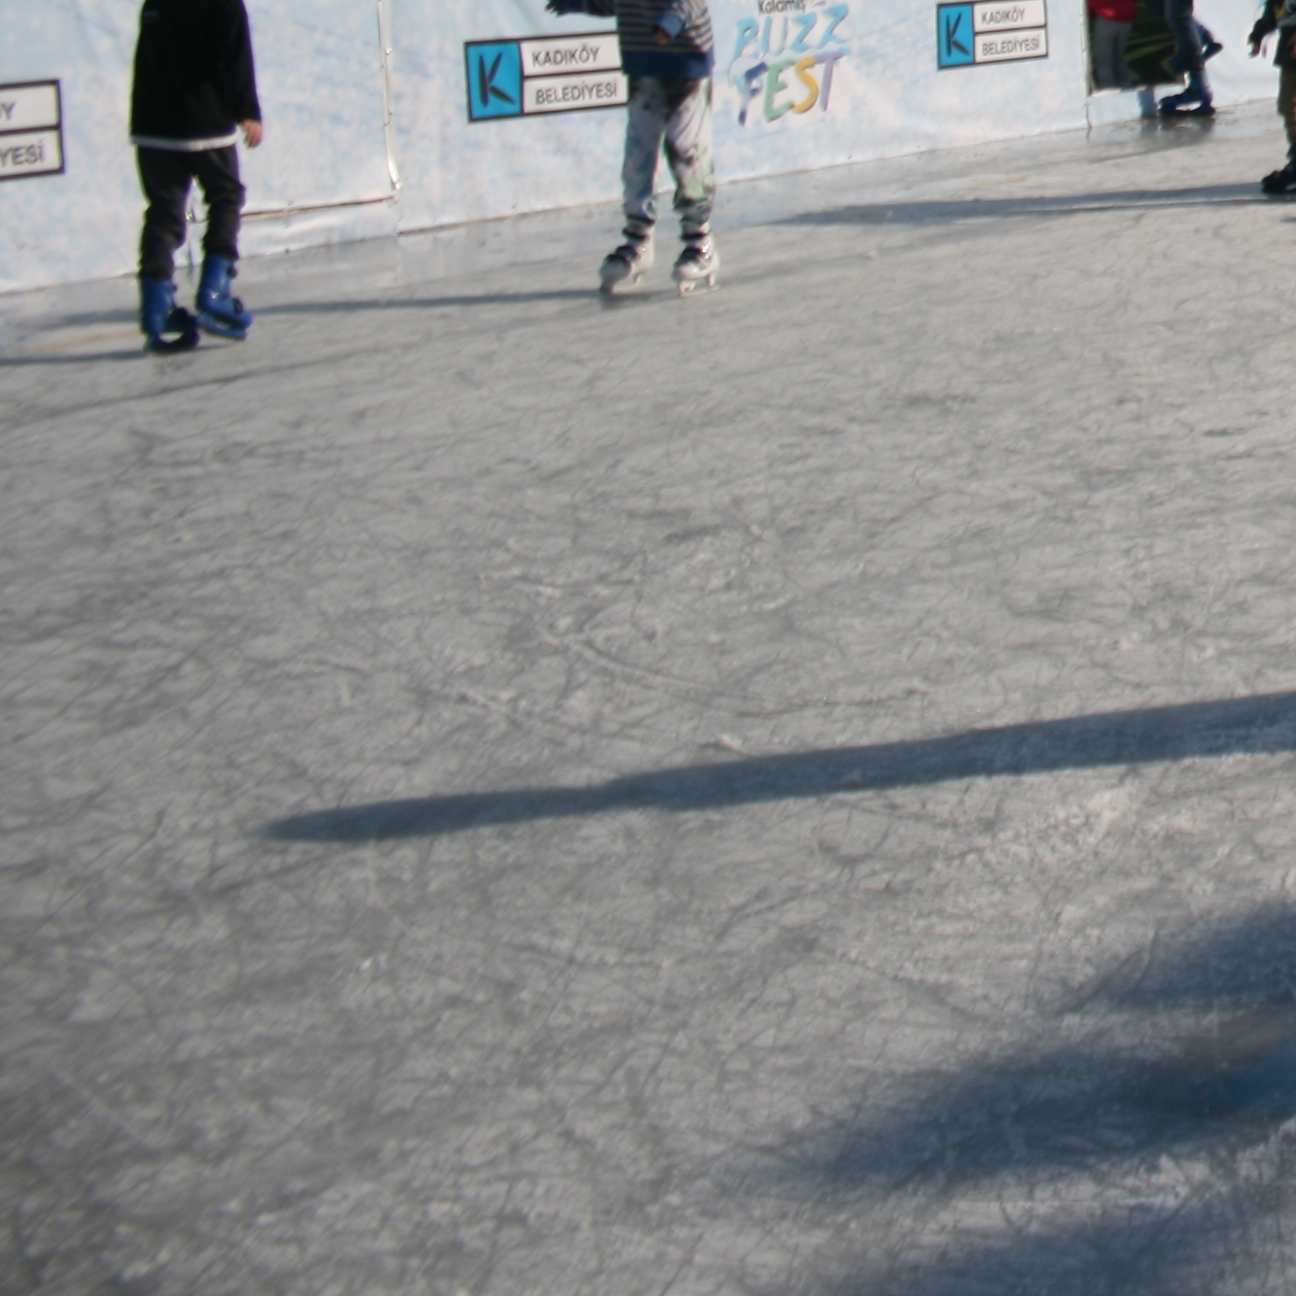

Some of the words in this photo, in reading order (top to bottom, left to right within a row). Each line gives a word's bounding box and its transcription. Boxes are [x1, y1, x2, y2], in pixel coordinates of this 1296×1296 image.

[981, 7, 1026, 25] KADIKÖY
[532, 45, 600, 68] KADIKÖY
[982, 35, 1040, 56] BELEDİYESİ
[536, 79, 618, 105] BELEDİYESİ
[737, 51, 845, 127] FEST
